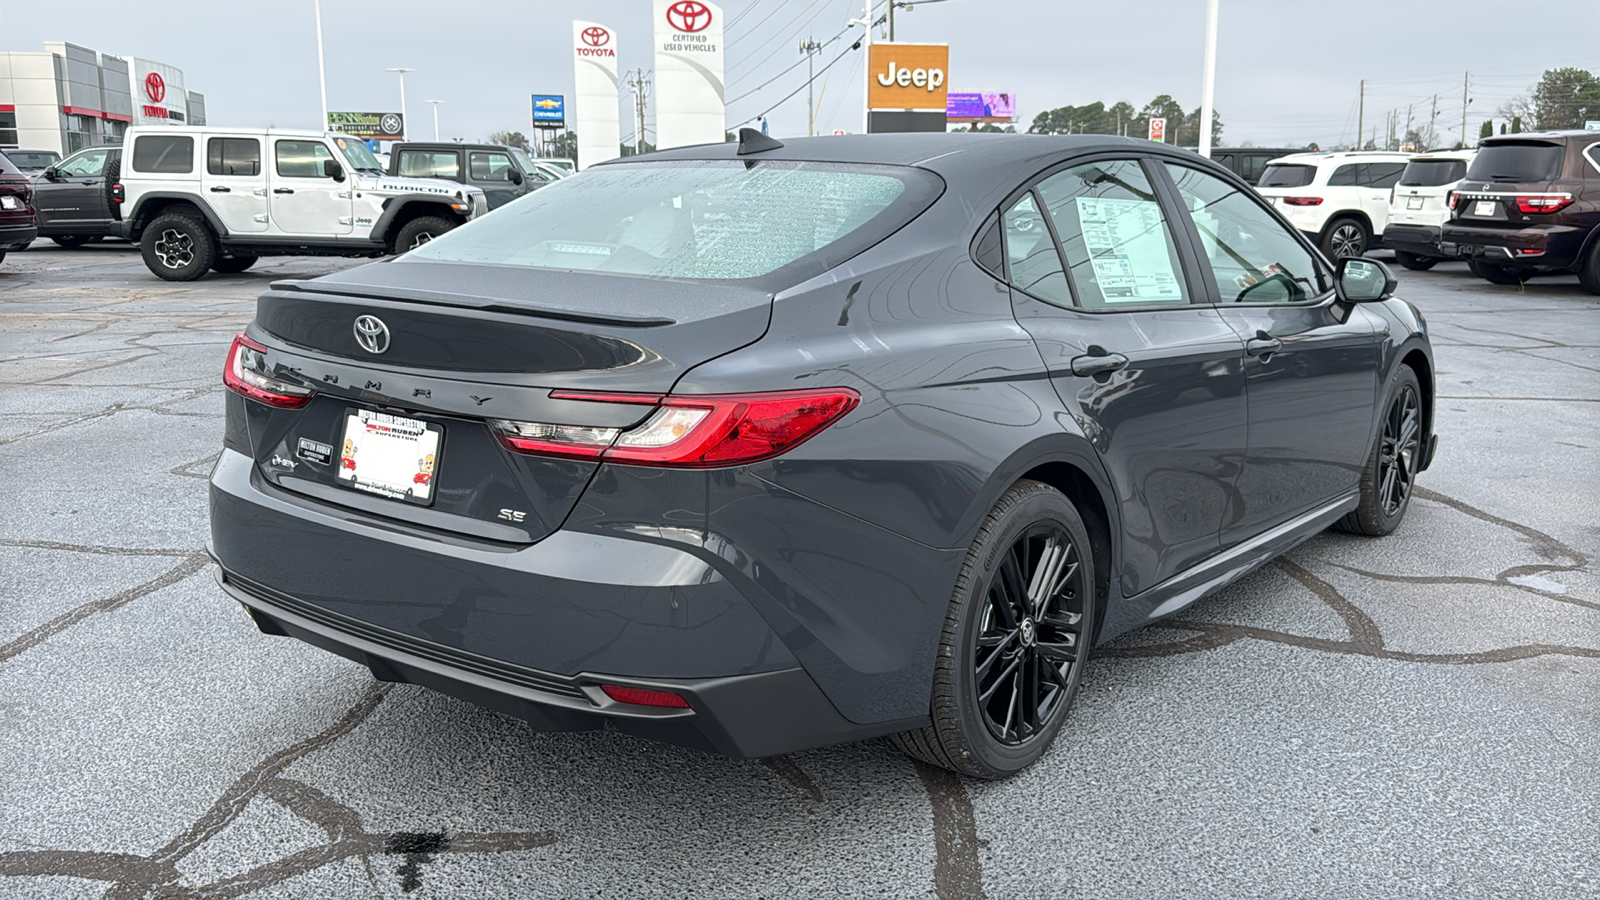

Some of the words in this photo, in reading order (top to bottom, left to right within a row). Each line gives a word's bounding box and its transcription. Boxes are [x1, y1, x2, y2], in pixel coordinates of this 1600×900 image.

[672, 34, 707, 43] CERTIFIED
[576, 48, 616, 57] TOYOTA
[664, 43, 682, 51] USED
[684, 44, 716, 53] VEHICLES
[877, 61, 944, 92] Jeep
[143, 105, 169, 119] TOYOTA
[383, 184, 449, 194] RUBICON
[355, 217, 372, 227] Jeep
[288, 366, 492, 406] CAMRY
[366, 423, 391, 432] MILTON
[391, 428, 419, 437] RUBEN
[375, 430, 418, 442] SUPERSTORE
[498, 508, 527, 523] SE
[983, 516, 1017, 573] Continental
